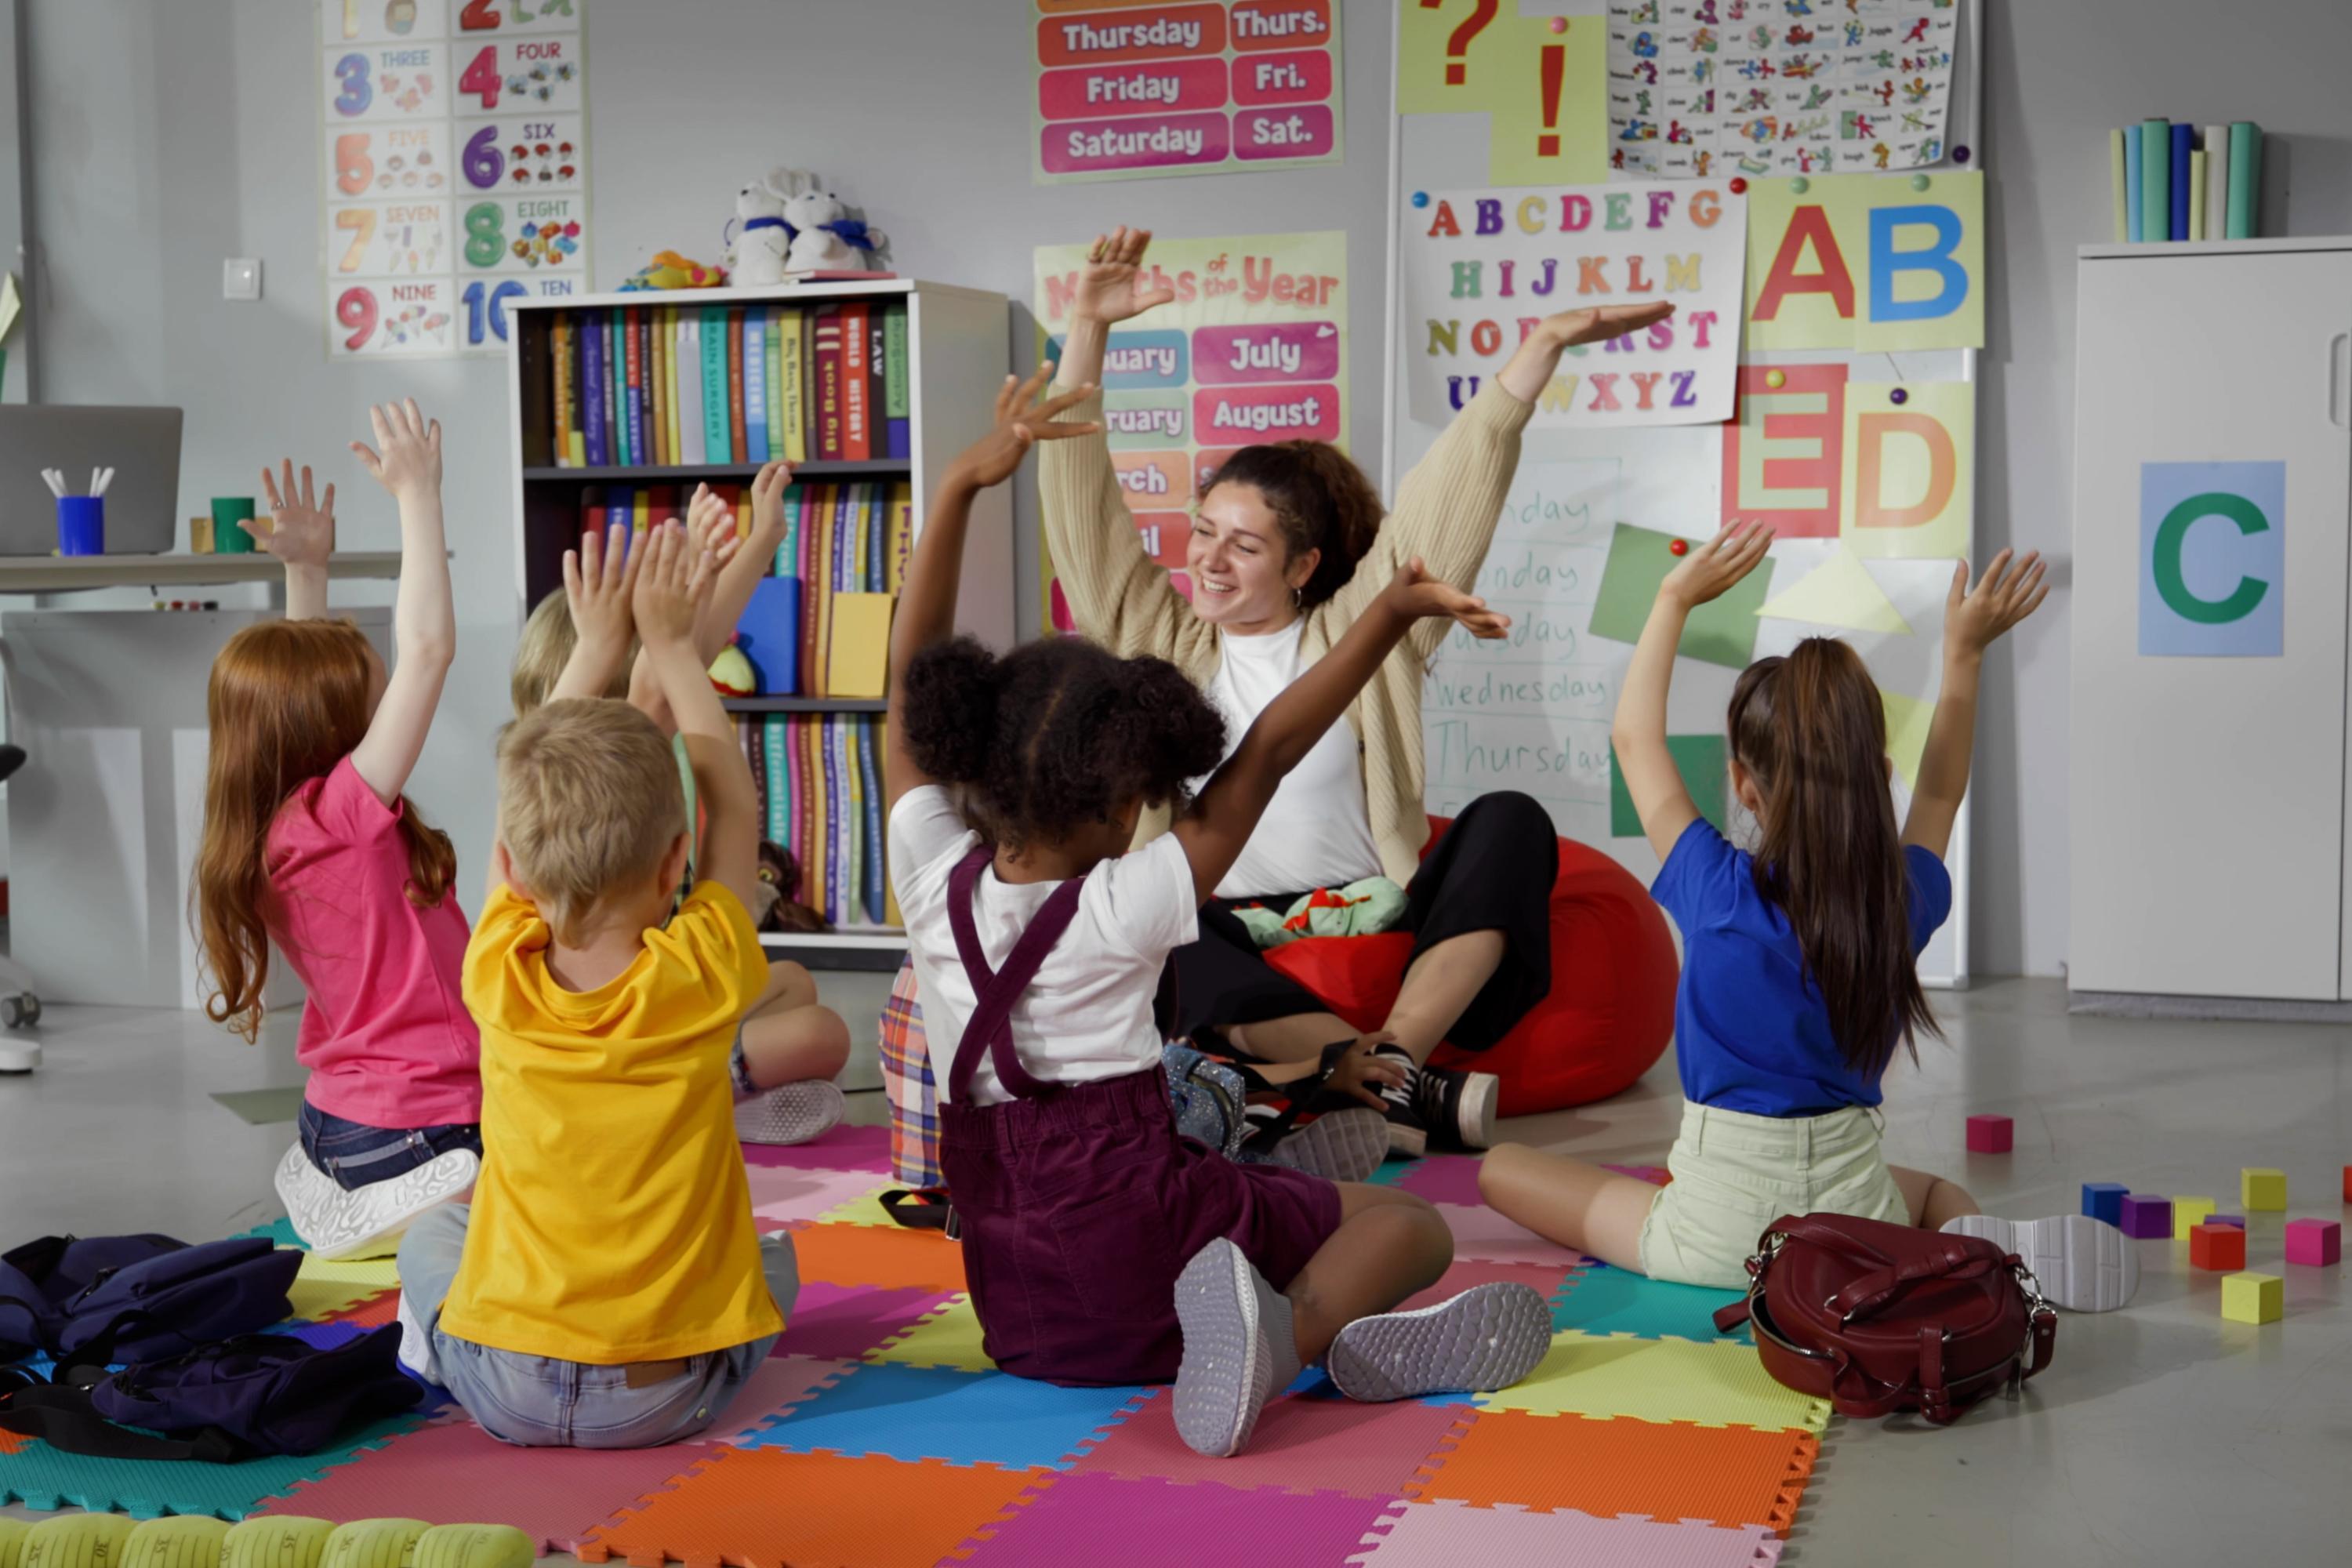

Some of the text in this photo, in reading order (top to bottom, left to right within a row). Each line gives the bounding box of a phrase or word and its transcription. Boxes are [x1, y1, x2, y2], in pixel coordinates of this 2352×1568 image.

[1063, 9, 1327, 52] Thursday Thurs.
[334, 50, 430, 117] 3 THREE
[459, 42, 561, 110] 4 FOUR
[1087, 64, 1307, 104] Friday Fri.
[336, 130, 430, 196] 5 FIVE
[462, 124, 555, 189] 6 SIX
[1068, 114, 1313, 158] Saturday Sat.
[336, 206, 440, 273] 7 SEVEN
[464, 201, 569, 268] 8 EIGHT
[1427, 191, 1722, 237] A B C D E F G
[1045, 253, 1340, 321] Mths of the Year
[1450, 252, 1702, 298] H I J K L M
[1750, 204, 1969, 323] A B
[336, 285, 437, 351] 9 NINE
[461, 280, 572, 345] 10 TEN
[1426, 319, 1461, 357] N
[1470, 319, 1501, 357] O
[1646, 317, 1674, 350] S
[1688, 310, 1718, 348] T
[708, 314, 720, 440] BRAIN SURGERY
[748, 330, 764, 415] MEDICINE
[848, 317, 862, 442] WORLD HISTORY
[872, 329, 883, 376] LAW
[1102, 336, 1301, 376] uary July
[786, 337, 799, 436] Big Bang Theory
[824, 361, 838, 452] Big Book
[1105, 397, 1321, 436] ruary August
[1447, 376, 1481, 411] U
[1541, 370, 1697, 412] W X Y Z
[629, 390, 641, 459] POLITICS
[1116, 464, 1167, 493] rch
[1737, 392, 1957, 528] E D
[1504, 490, 1590, 535] nday
[806, 501, 823, 645] University Physics
[2151, 492, 2270, 625] C
[1432, 672, 1607, 707] Wednesday
[1429, 720, 1611, 784] Thursday
[800, 727, 815, 873] University Physics
[95, 1540, 109, 1558] 30
[156, 1538, 169, 1554] 35
[283, 1534, 296, 1550] 45
